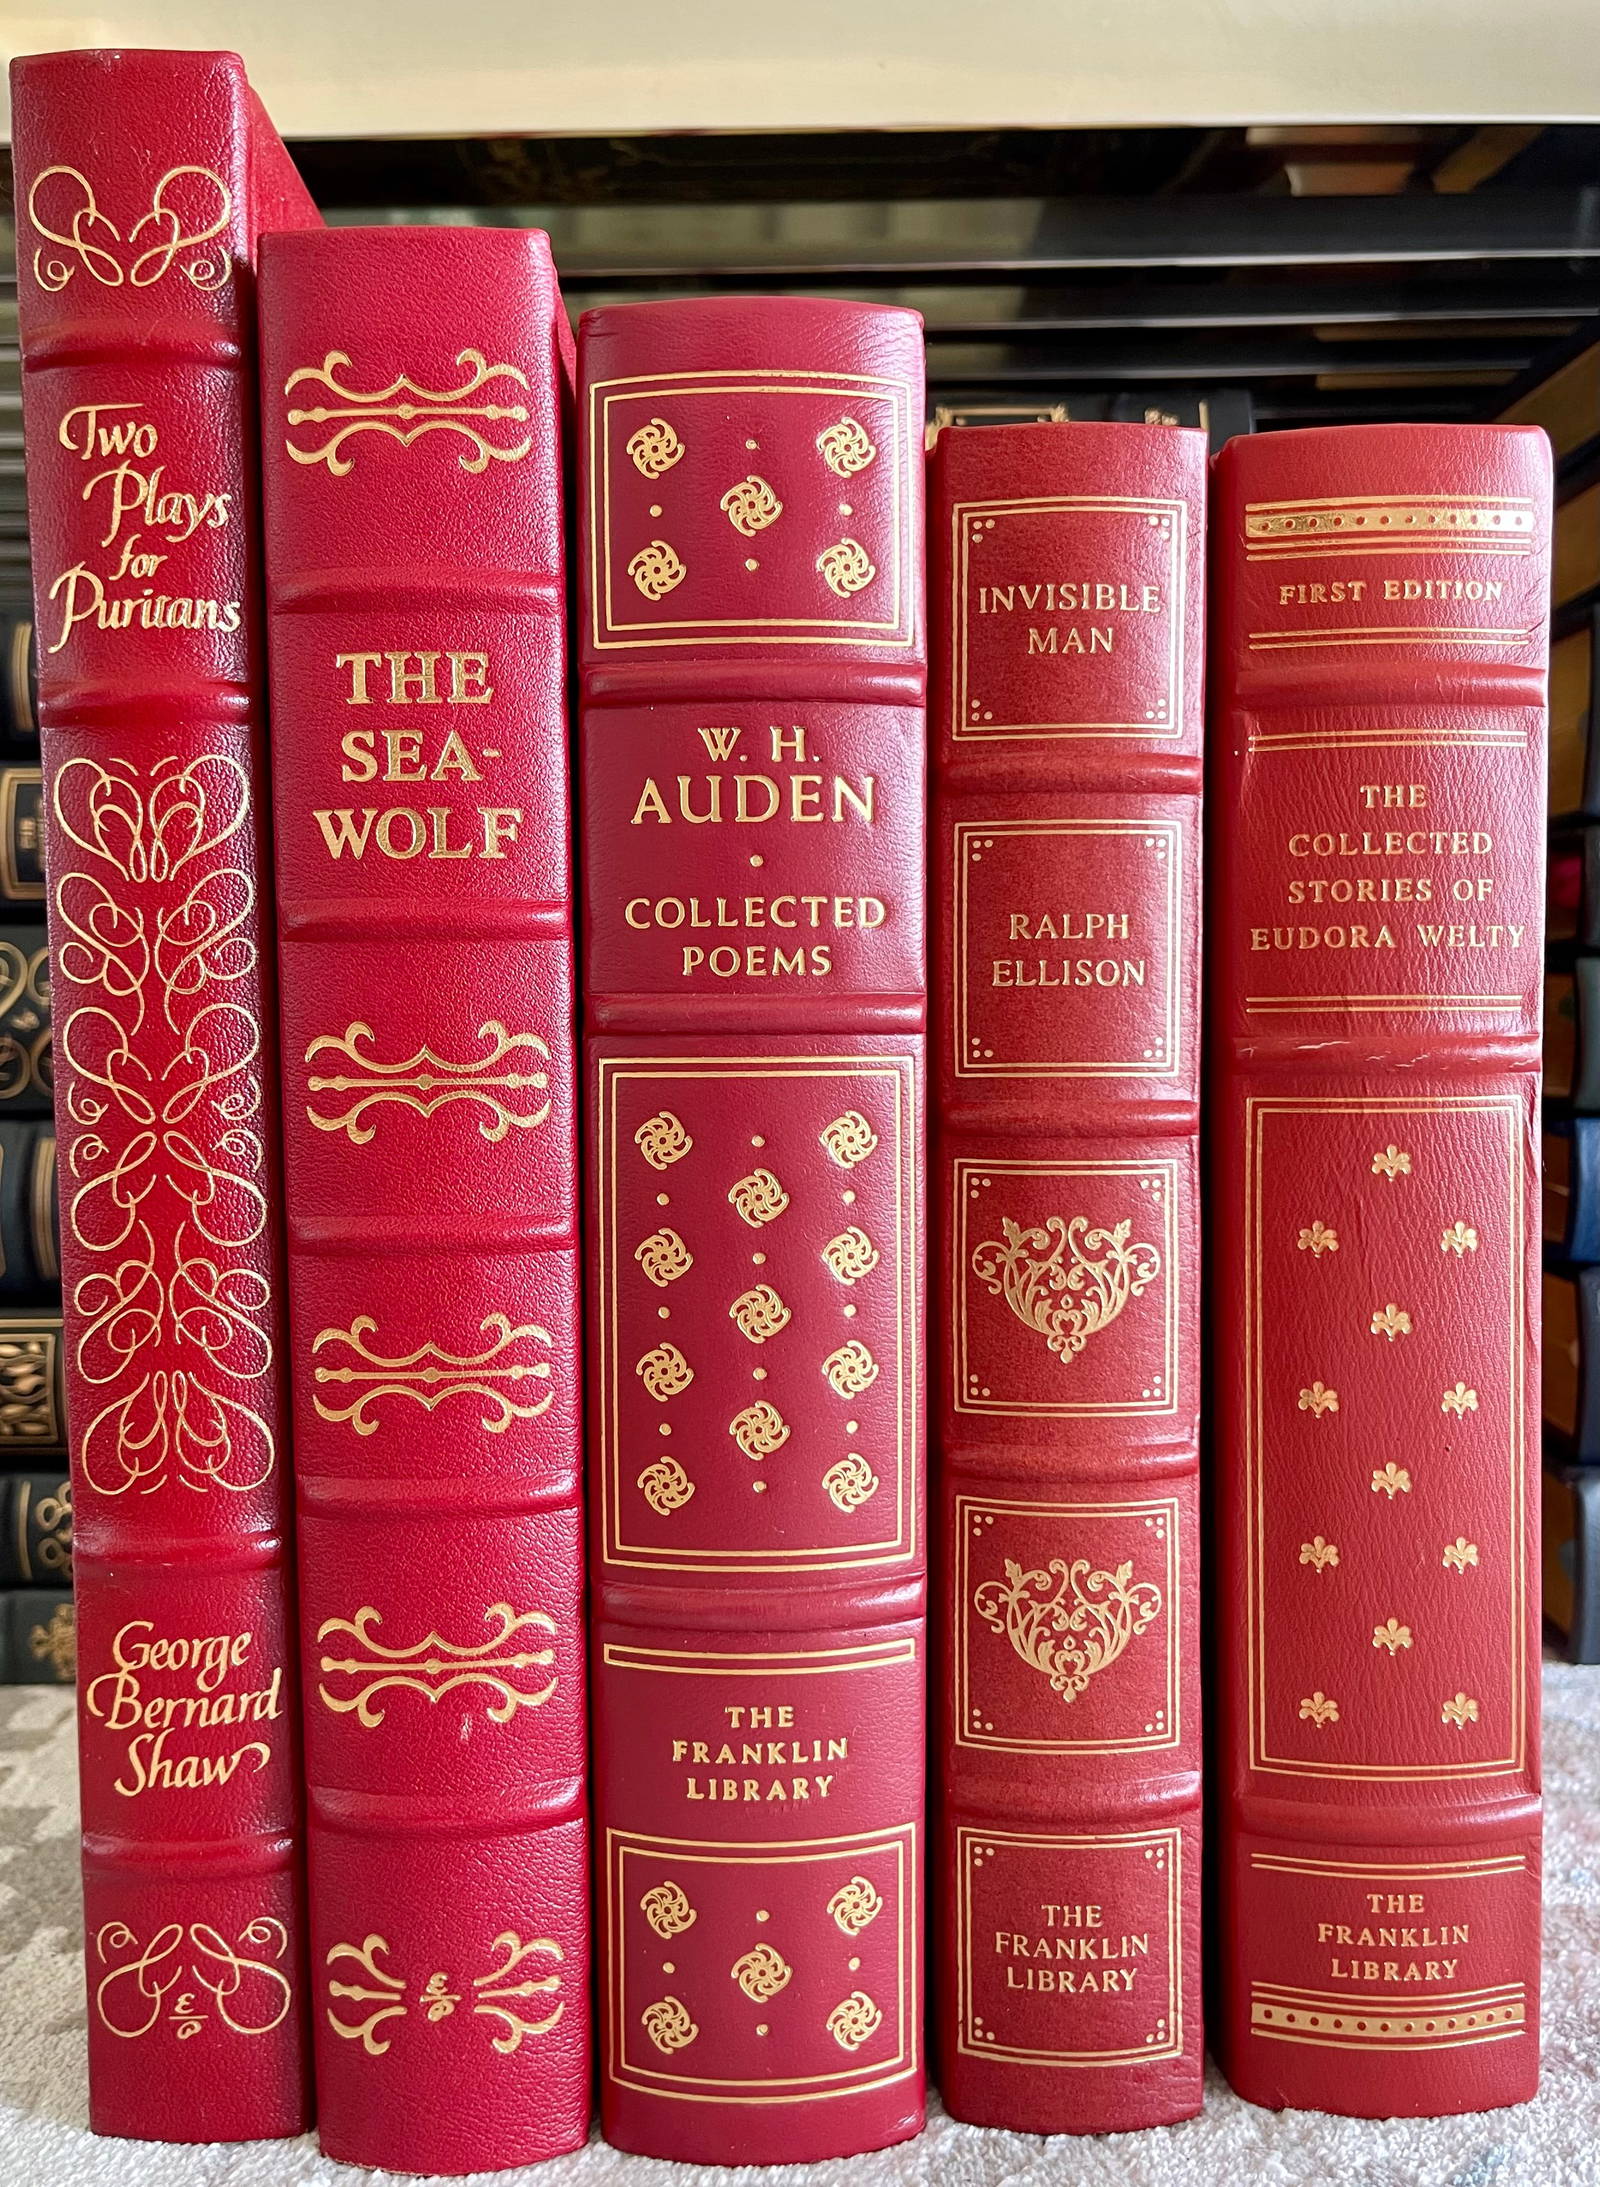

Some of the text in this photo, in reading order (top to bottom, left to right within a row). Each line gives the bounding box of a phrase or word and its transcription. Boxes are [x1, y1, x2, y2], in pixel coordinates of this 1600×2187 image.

[59, 404, 158, 460] Two
[84, 461, 230, 547] Plays
[109, 534, 168, 581] for
[978, 584, 1161, 614] INVISIBLE
[1280, 580, 1504, 605] FIRST EDITION
[49, 562, 241, 653] Puritans
[1028, 629, 1114, 654] MAN
[336, 651, 493, 705] THE
[341, 729, 502, 782] SEA-
[697, 727, 820, 762] W. H.
[632, 774, 875, 825] AUDEN
[1361, 785, 1426, 808] THE
[313, 807, 522, 860] WOLF
[1288, 831, 1493, 857] COLLECTED
[1288, 878, 1493, 903] STORIES OF
[625, 897, 886, 929] COLLECTED
[1009, 913, 1130, 940] RALPH
[1251, 925, 1525, 950] EUDORA WELTY
[682, 945, 832, 976] POEMS
[992, 959, 1145, 988] ELLISON
[114, 1621, 251, 1692] George
[87, 1668, 283, 1730] Bernard
[725, 1705, 794, 1729] THE
[115, 1729, 269, 1796] Shaw
[672, 1736, 848, 1764] FRANKLIN
[686, 1775, 835, 1802] LIBRARY
[1042, 1904, 1103, 1928] THE
[1366, 1893, 1425, 1914] THE
[995, 1935, 1149, 1959] FRANKLIN
[1318, 1923, 1469, 1947] FRANKLIN
[1006, 1965, 1138, 1993] LIBRARY
[1331, 1959, 1459, 1982] LIBRARY
